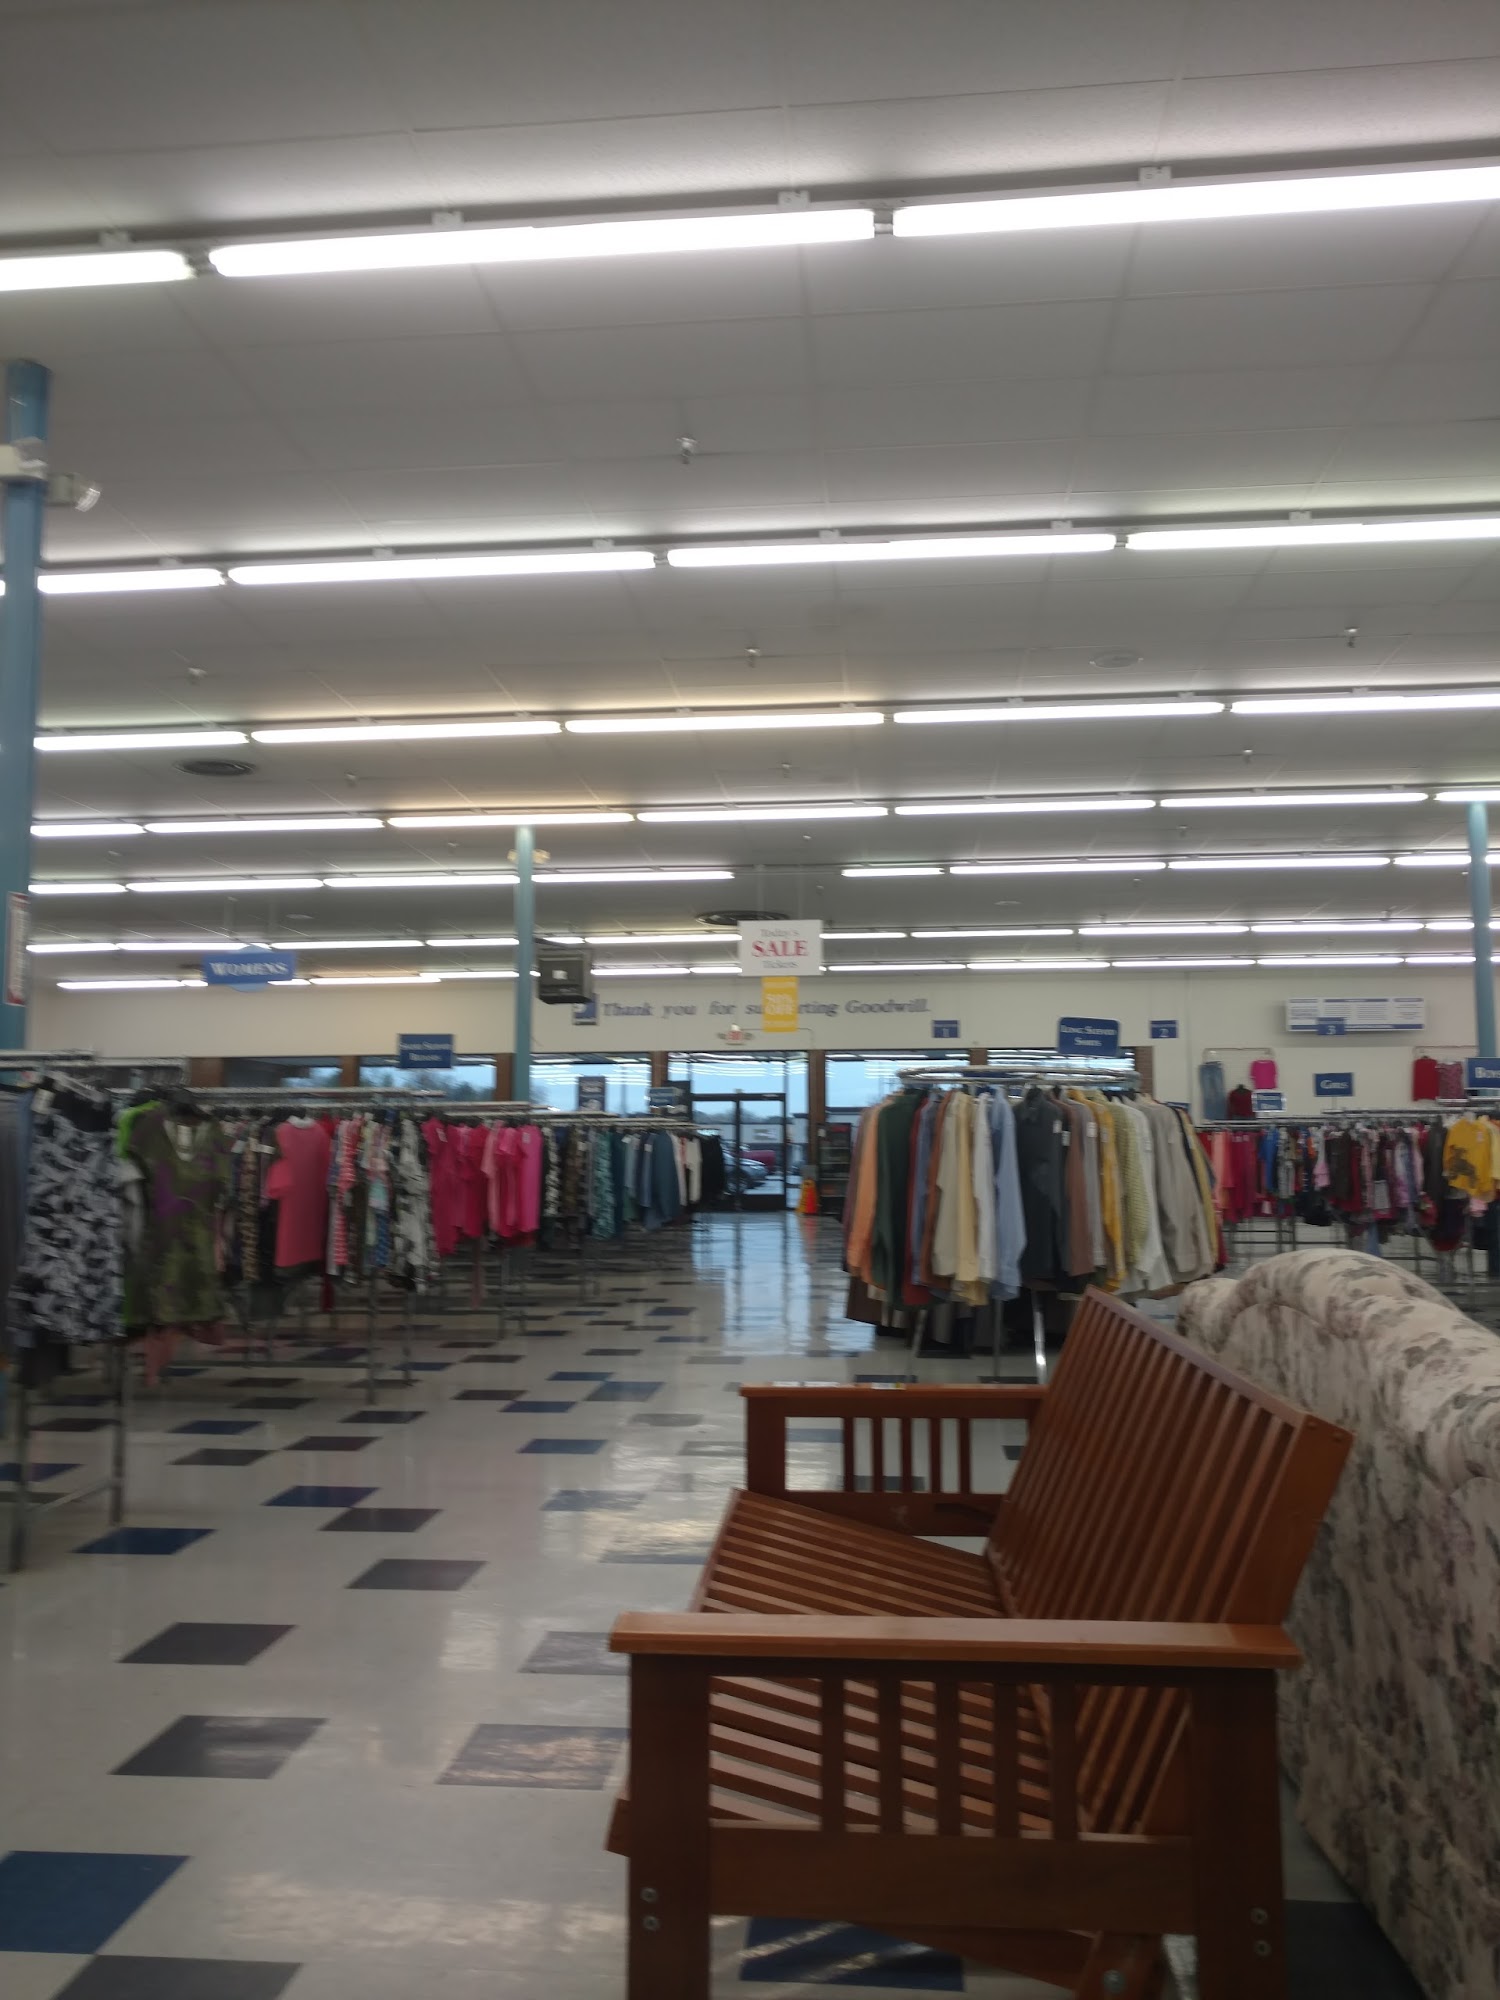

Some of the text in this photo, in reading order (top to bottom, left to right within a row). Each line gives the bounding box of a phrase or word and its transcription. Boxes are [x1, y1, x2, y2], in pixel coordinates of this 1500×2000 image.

[752, 940, 808, 957] SALE
[209, 962, 289, 977] WOMENS
[603, 1002, 653, 1016] Thank
[660, 1004, 697, 1018] you
[709, 1001, 736, 1015] for
[745, 1002, 839, 1017] surting
[1160, 1028, 1169, 1038] 2
[1326, 1025, 1337, 1035] 3
